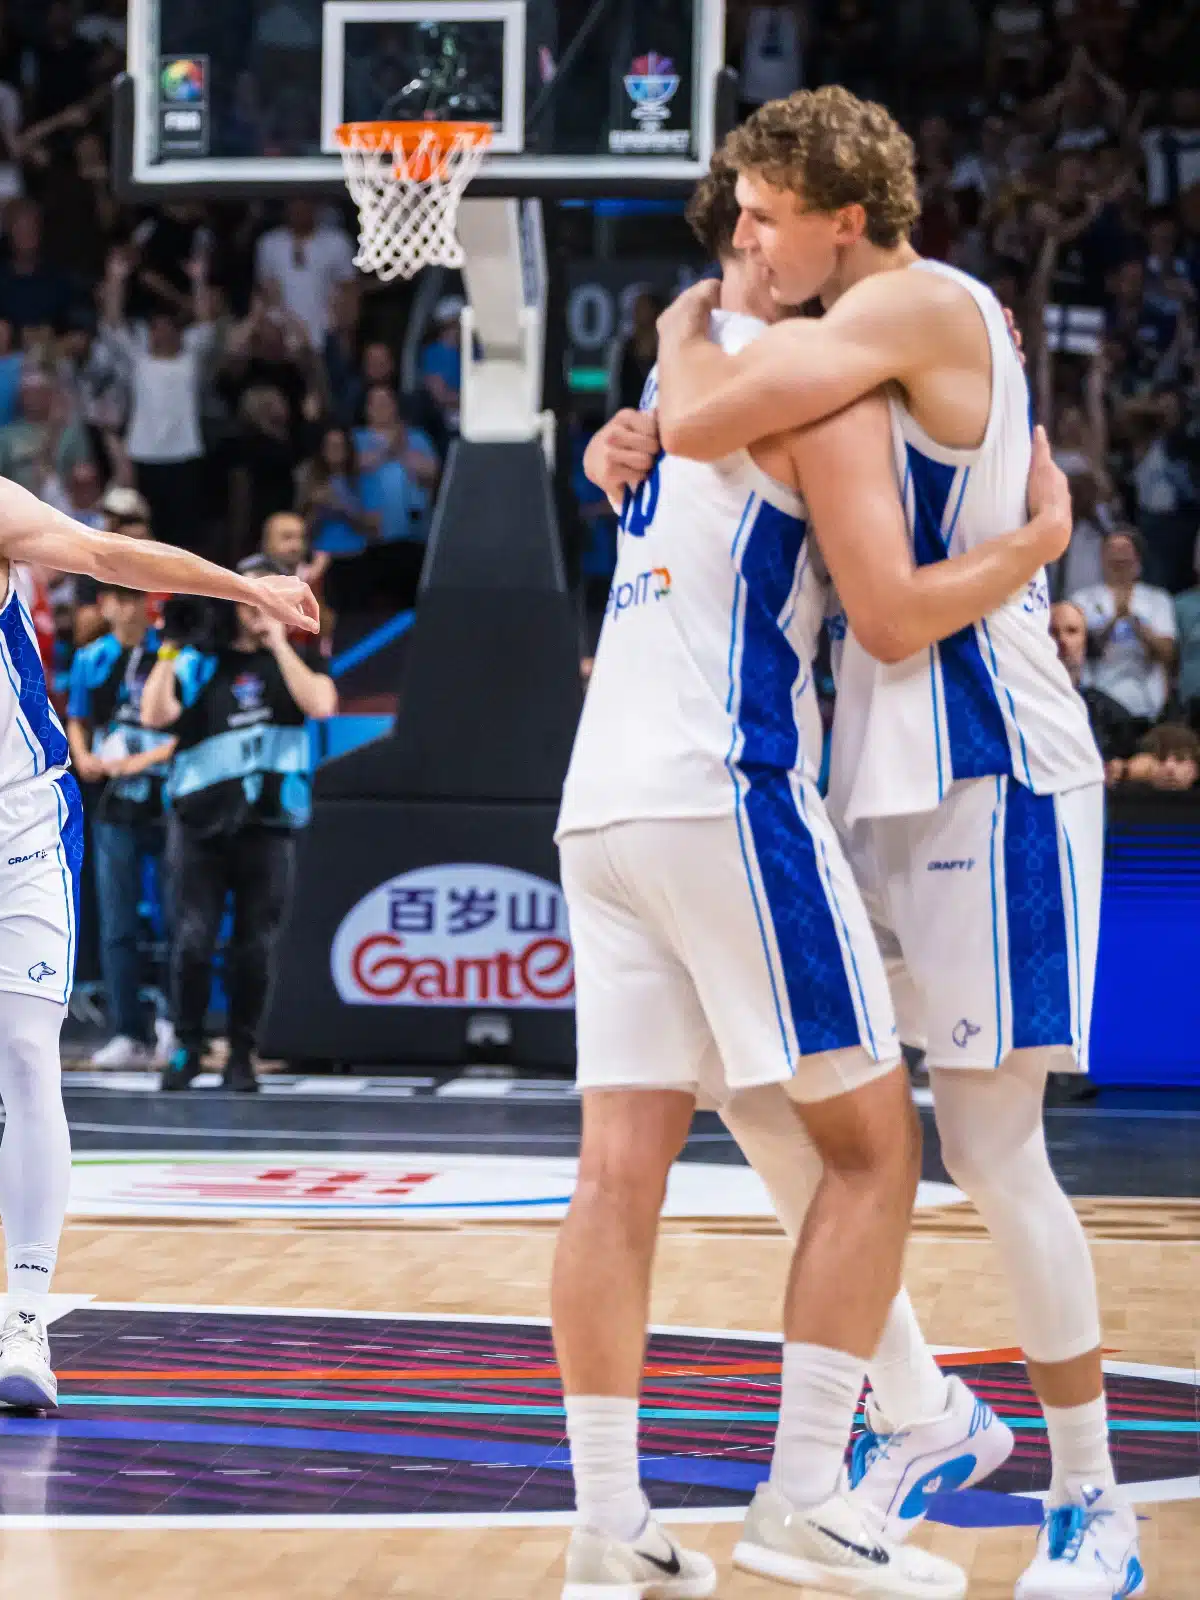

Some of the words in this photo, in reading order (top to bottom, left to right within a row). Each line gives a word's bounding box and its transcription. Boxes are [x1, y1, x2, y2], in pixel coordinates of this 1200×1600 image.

[388, 886, 558, 934] 百岁山
[13, 1263, 49, 1274] JAKO
